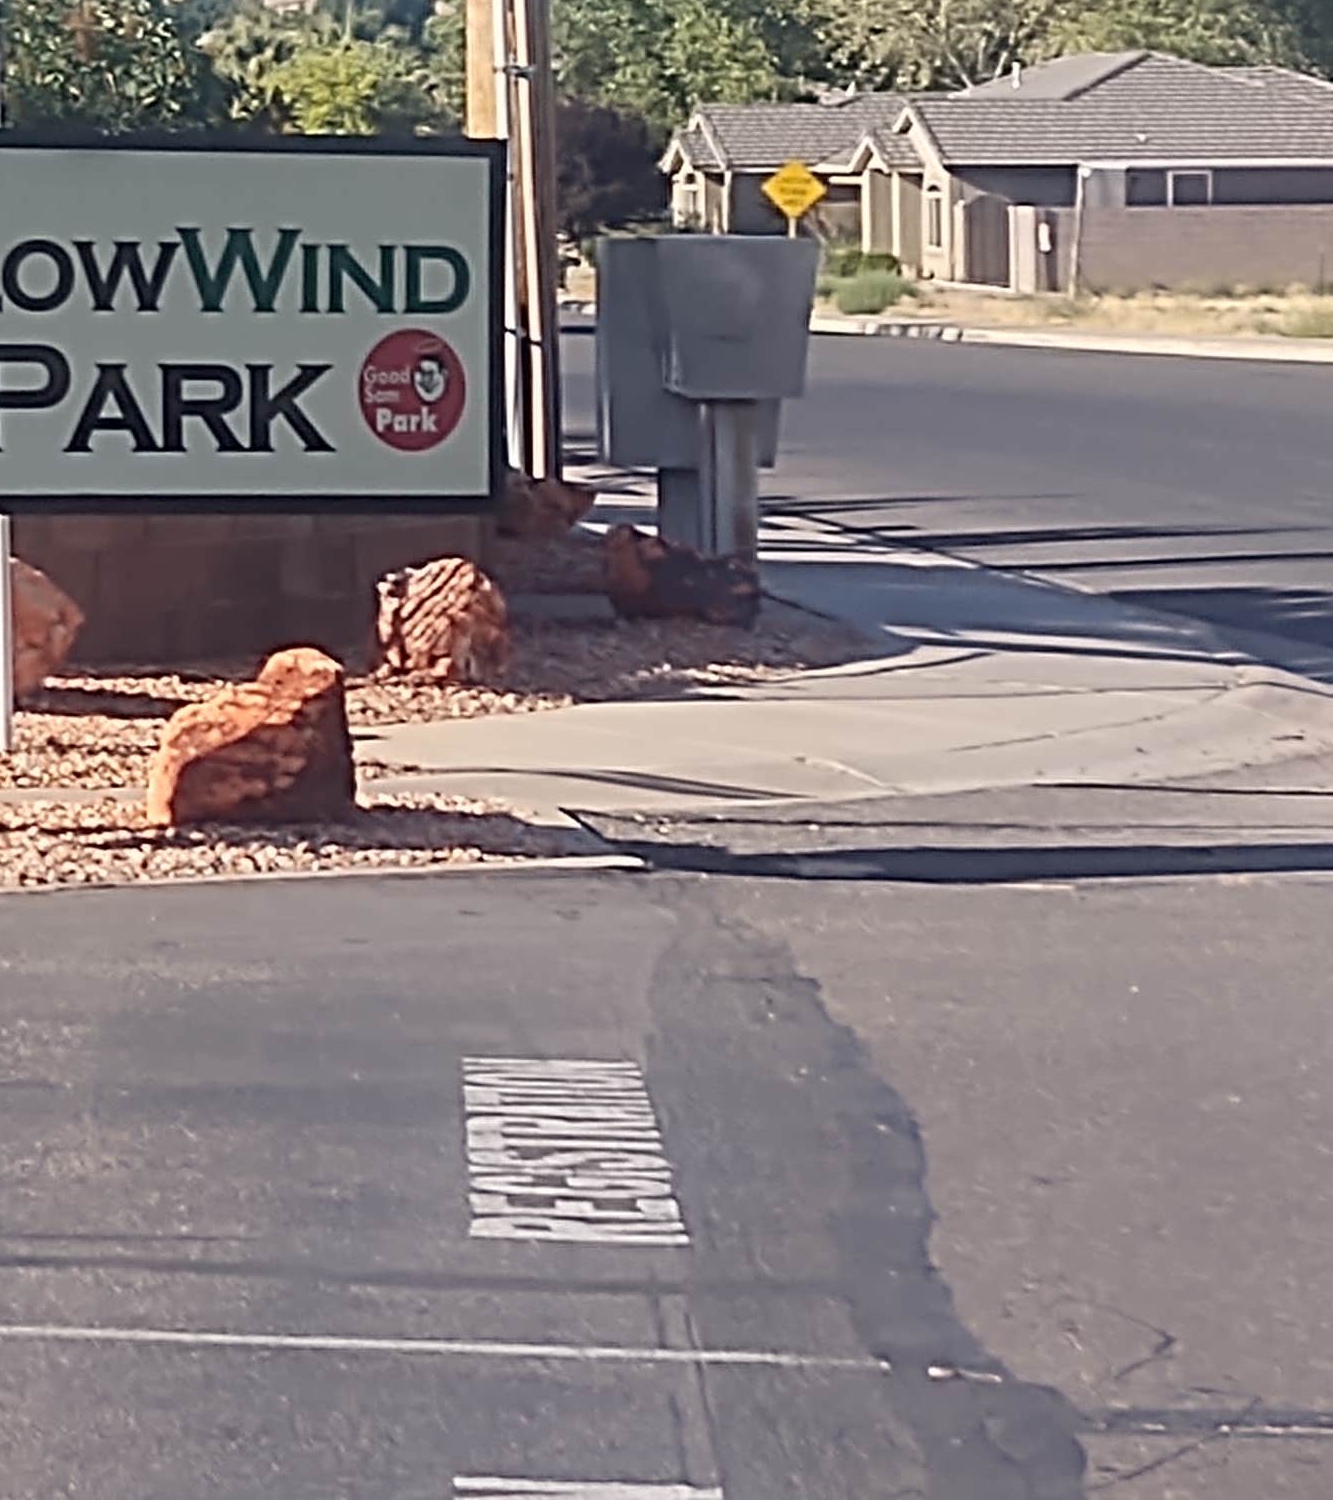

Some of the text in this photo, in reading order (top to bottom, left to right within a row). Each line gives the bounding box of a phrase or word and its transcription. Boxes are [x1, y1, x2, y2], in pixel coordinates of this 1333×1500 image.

[363, 365, 411, 384] Good
[375, 405, 437, 433] Park
[462, 1057, 690, 1245] REGISTRATION
